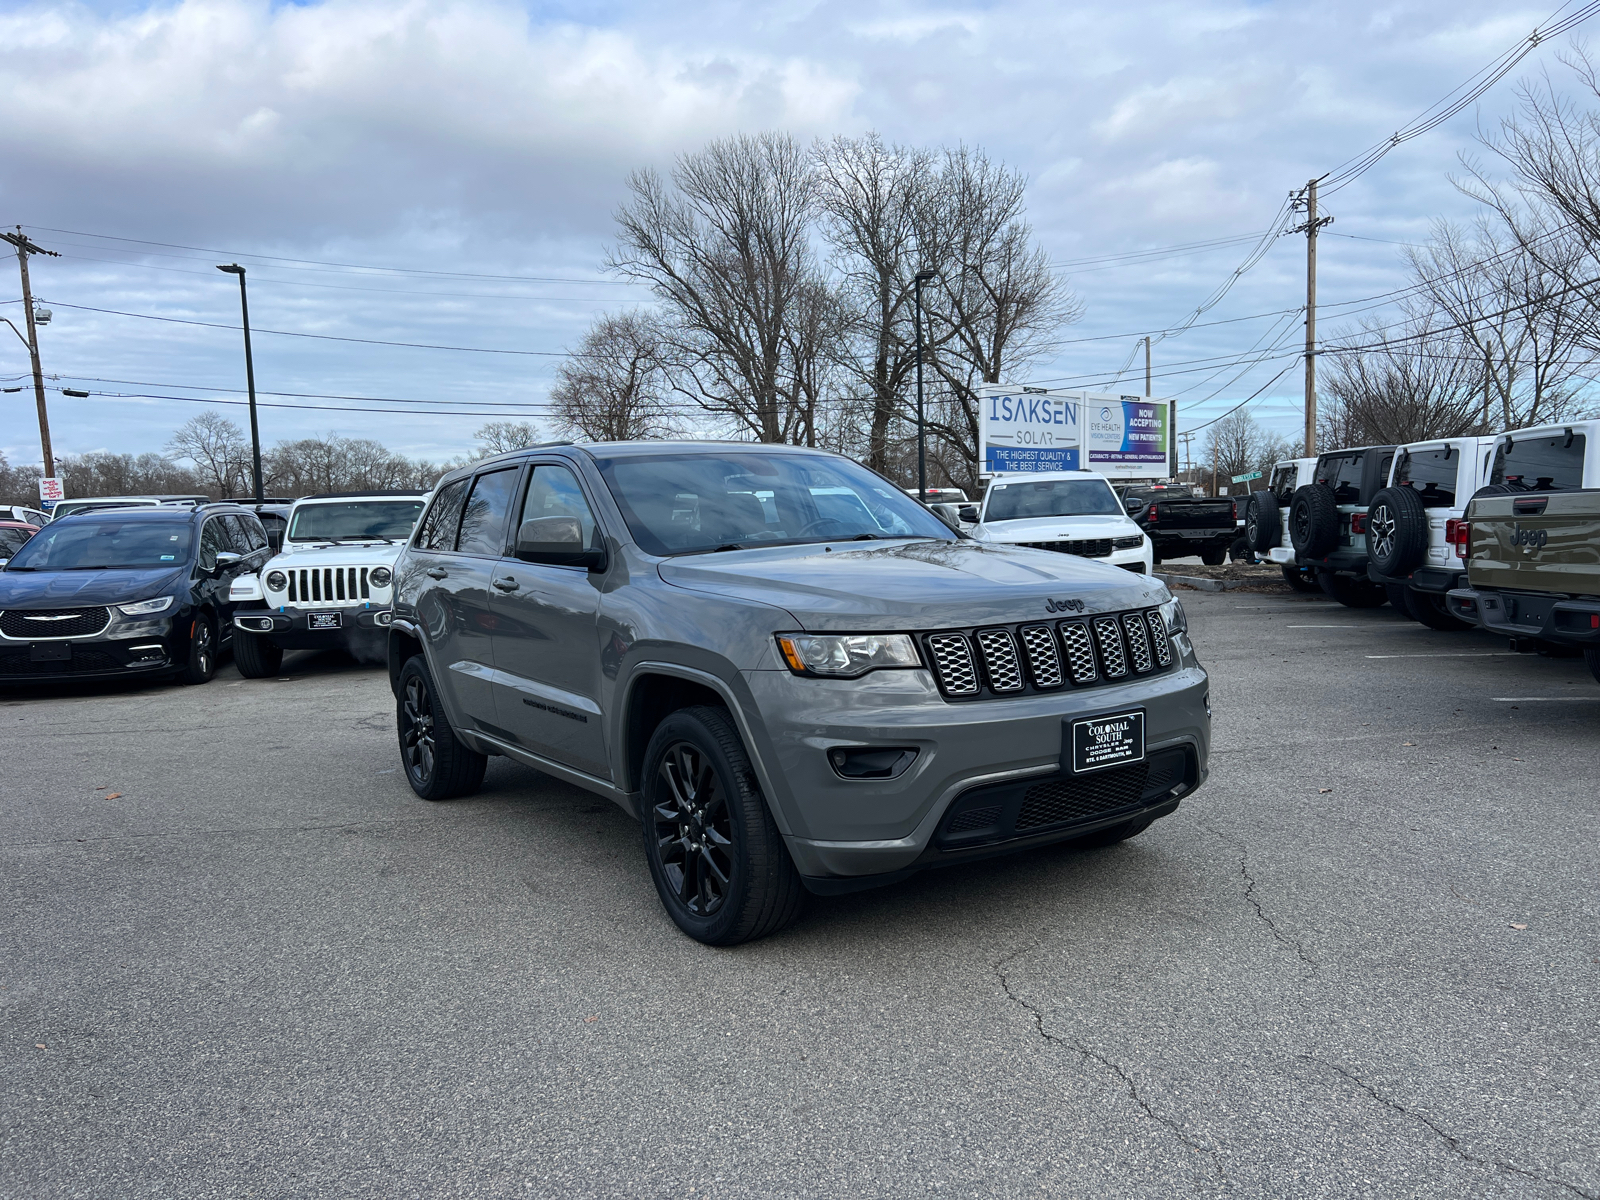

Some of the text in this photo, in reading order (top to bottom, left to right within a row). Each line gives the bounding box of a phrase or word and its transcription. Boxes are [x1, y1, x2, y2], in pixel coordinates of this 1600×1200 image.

[990, 396, 1076, 425] ISAKSEN
[1139, 409, 1154, 418] NOW
[1090, 422, 1121, 431] EYE HEALTH
[1129, 418, 1162, 428] ACCEPTING
[1016, 430, 1053, 445] SOLAR
[1128, 433, 1139, 441] NEW
[996, 450, 1071, 460] THE HIGHEST QUALITY &
[1005, 461, 1063, 470] THE BEST SERVICE
[1510, 524, 1547, 550] Jeep
[1045, 598, 1085, 613] Jeep
[1088, 721, 1129, 736] COLONIAL
[1095, 731, 1122, 744] SOUTH
[1085, 741, 1119, 751] CHRYSLER
[1089, 747, 1112, 756] DODGE
